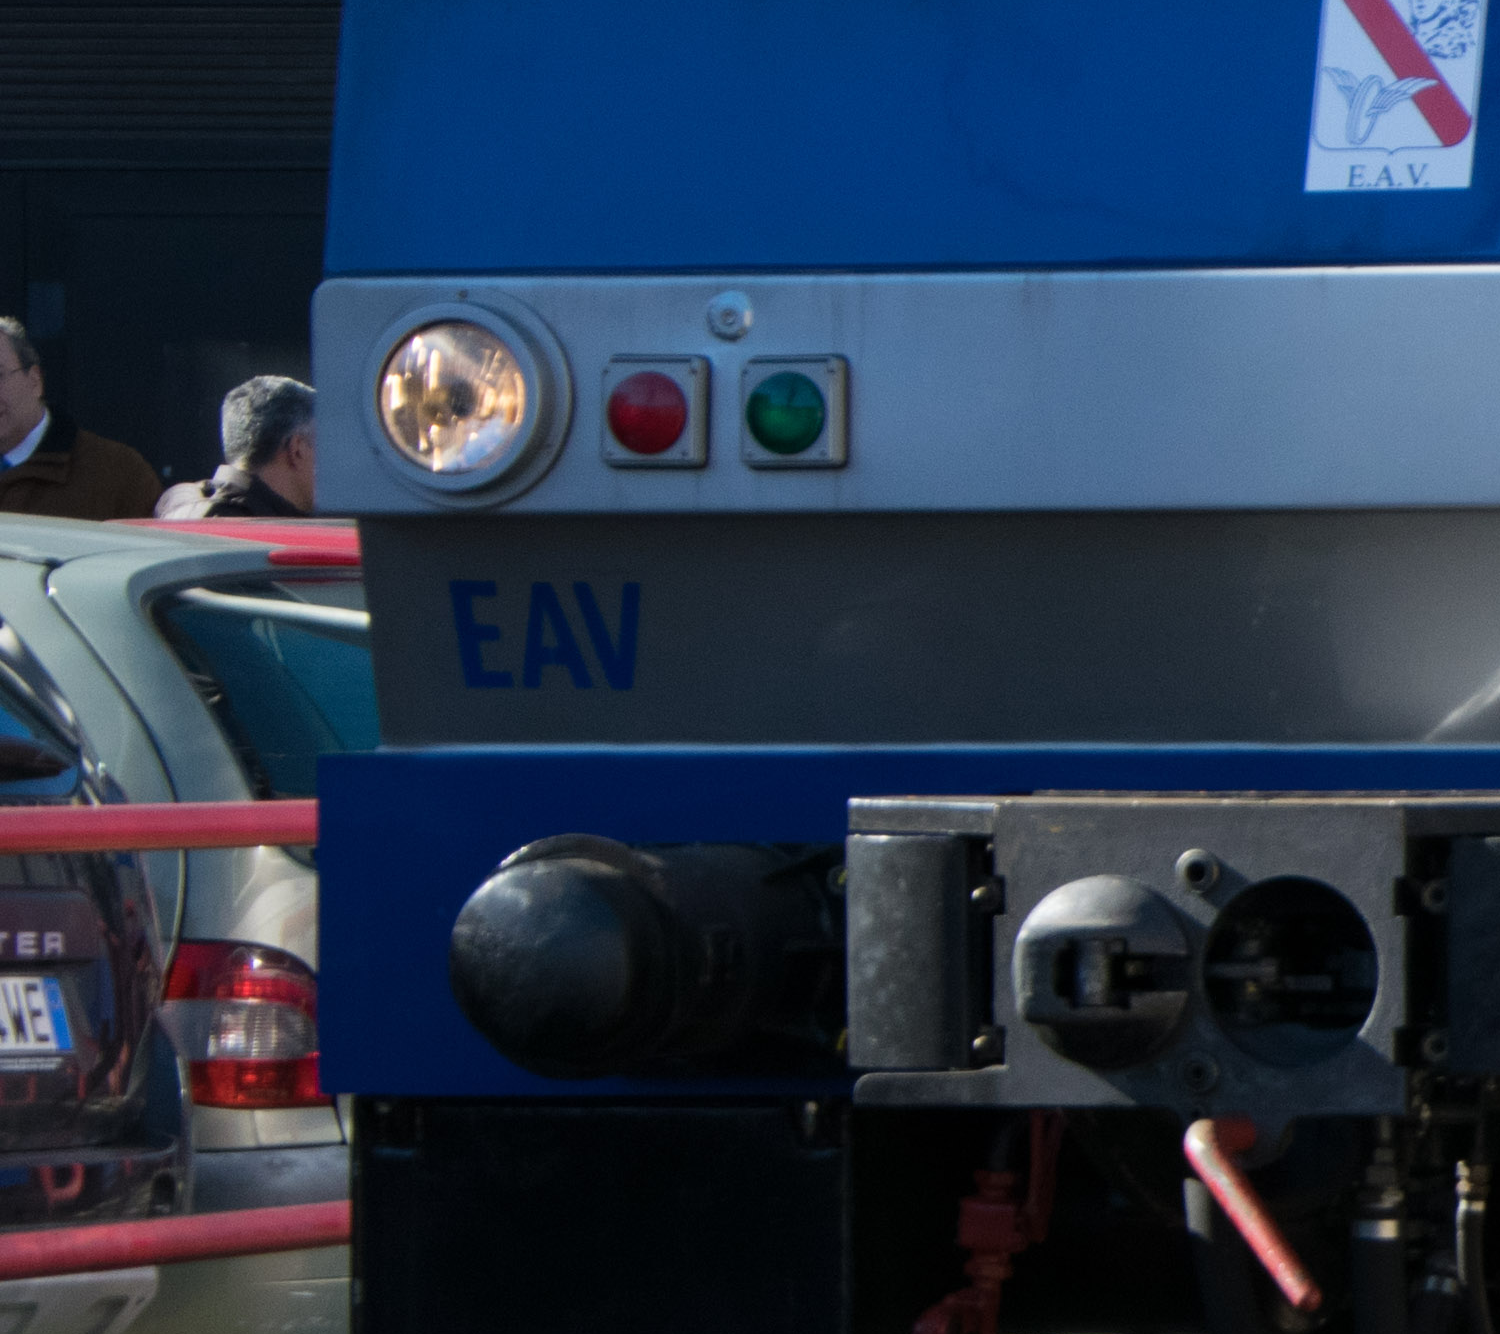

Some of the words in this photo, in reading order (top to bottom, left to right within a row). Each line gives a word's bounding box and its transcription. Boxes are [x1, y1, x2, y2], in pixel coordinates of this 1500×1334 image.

[1347, 163, 1430, 187] E.A.V.
[448, 580, 641, 690] EAV
[0, 982, 50, 1043] WE
